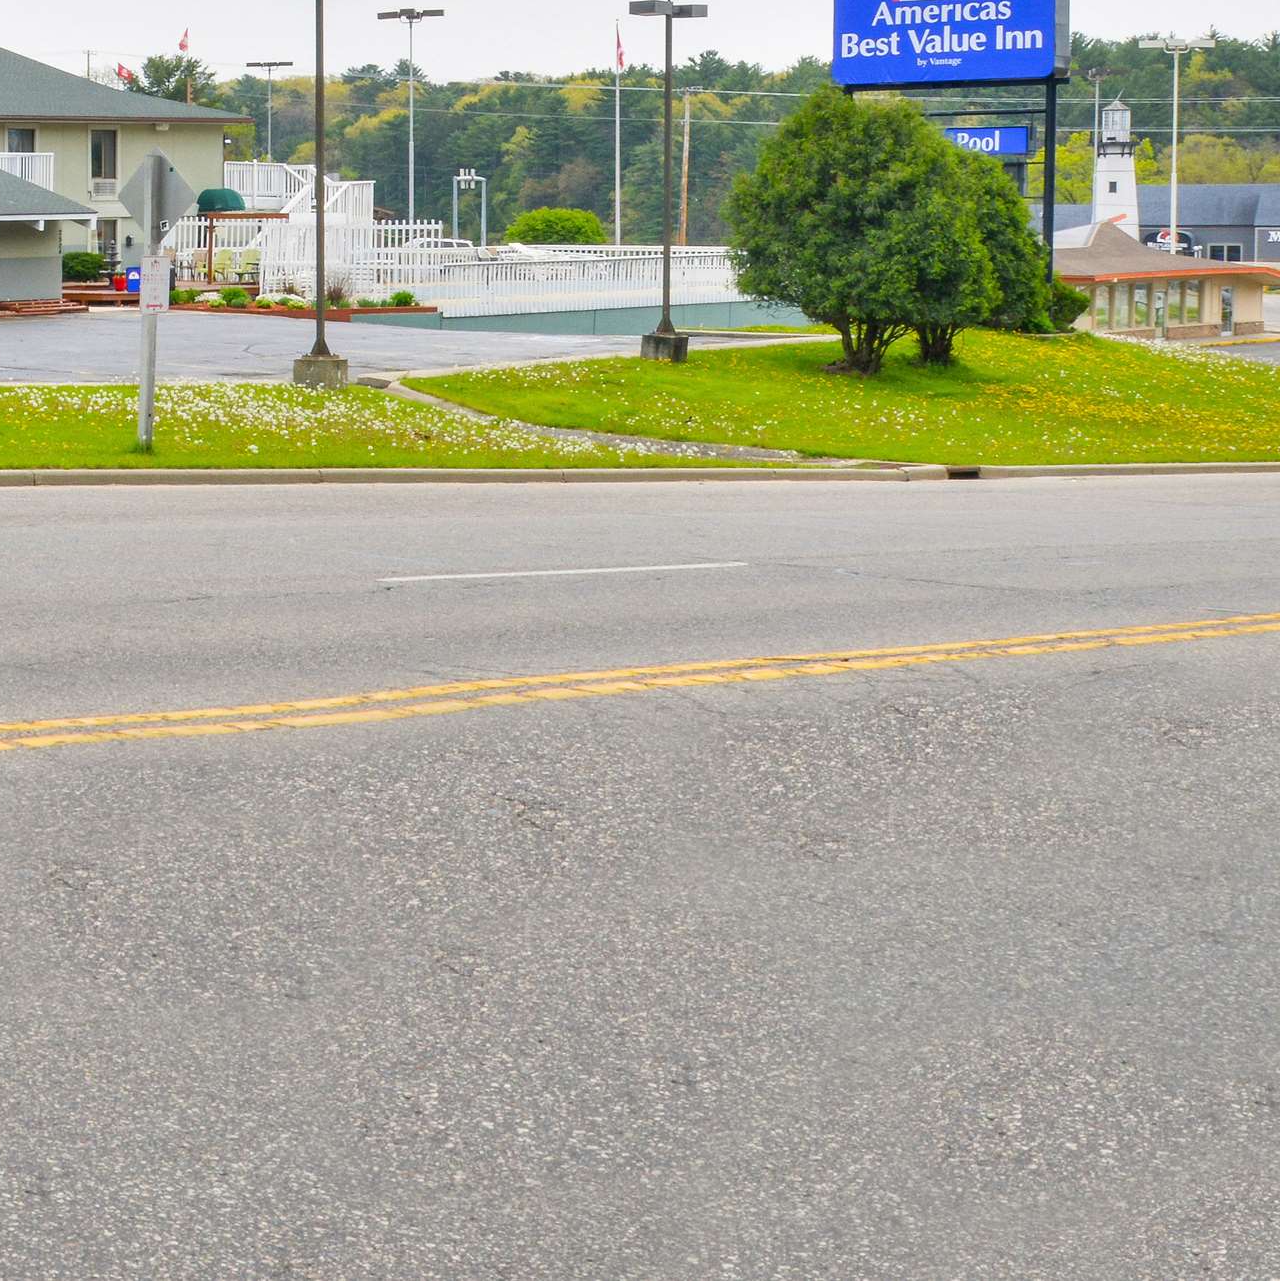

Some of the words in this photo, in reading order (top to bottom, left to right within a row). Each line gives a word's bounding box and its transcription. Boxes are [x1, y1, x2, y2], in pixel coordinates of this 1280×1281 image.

[871, 0, 1012, 27] Americas
[841, 32, 901, 58] Best
[908, 25, 987, 54] Value
[996, 25, 1043, 51] Inn
[916, 57, 928, 68] by
[929, 57, 962, 67] Vantage
[956, 130, 1000, 152] Pool
